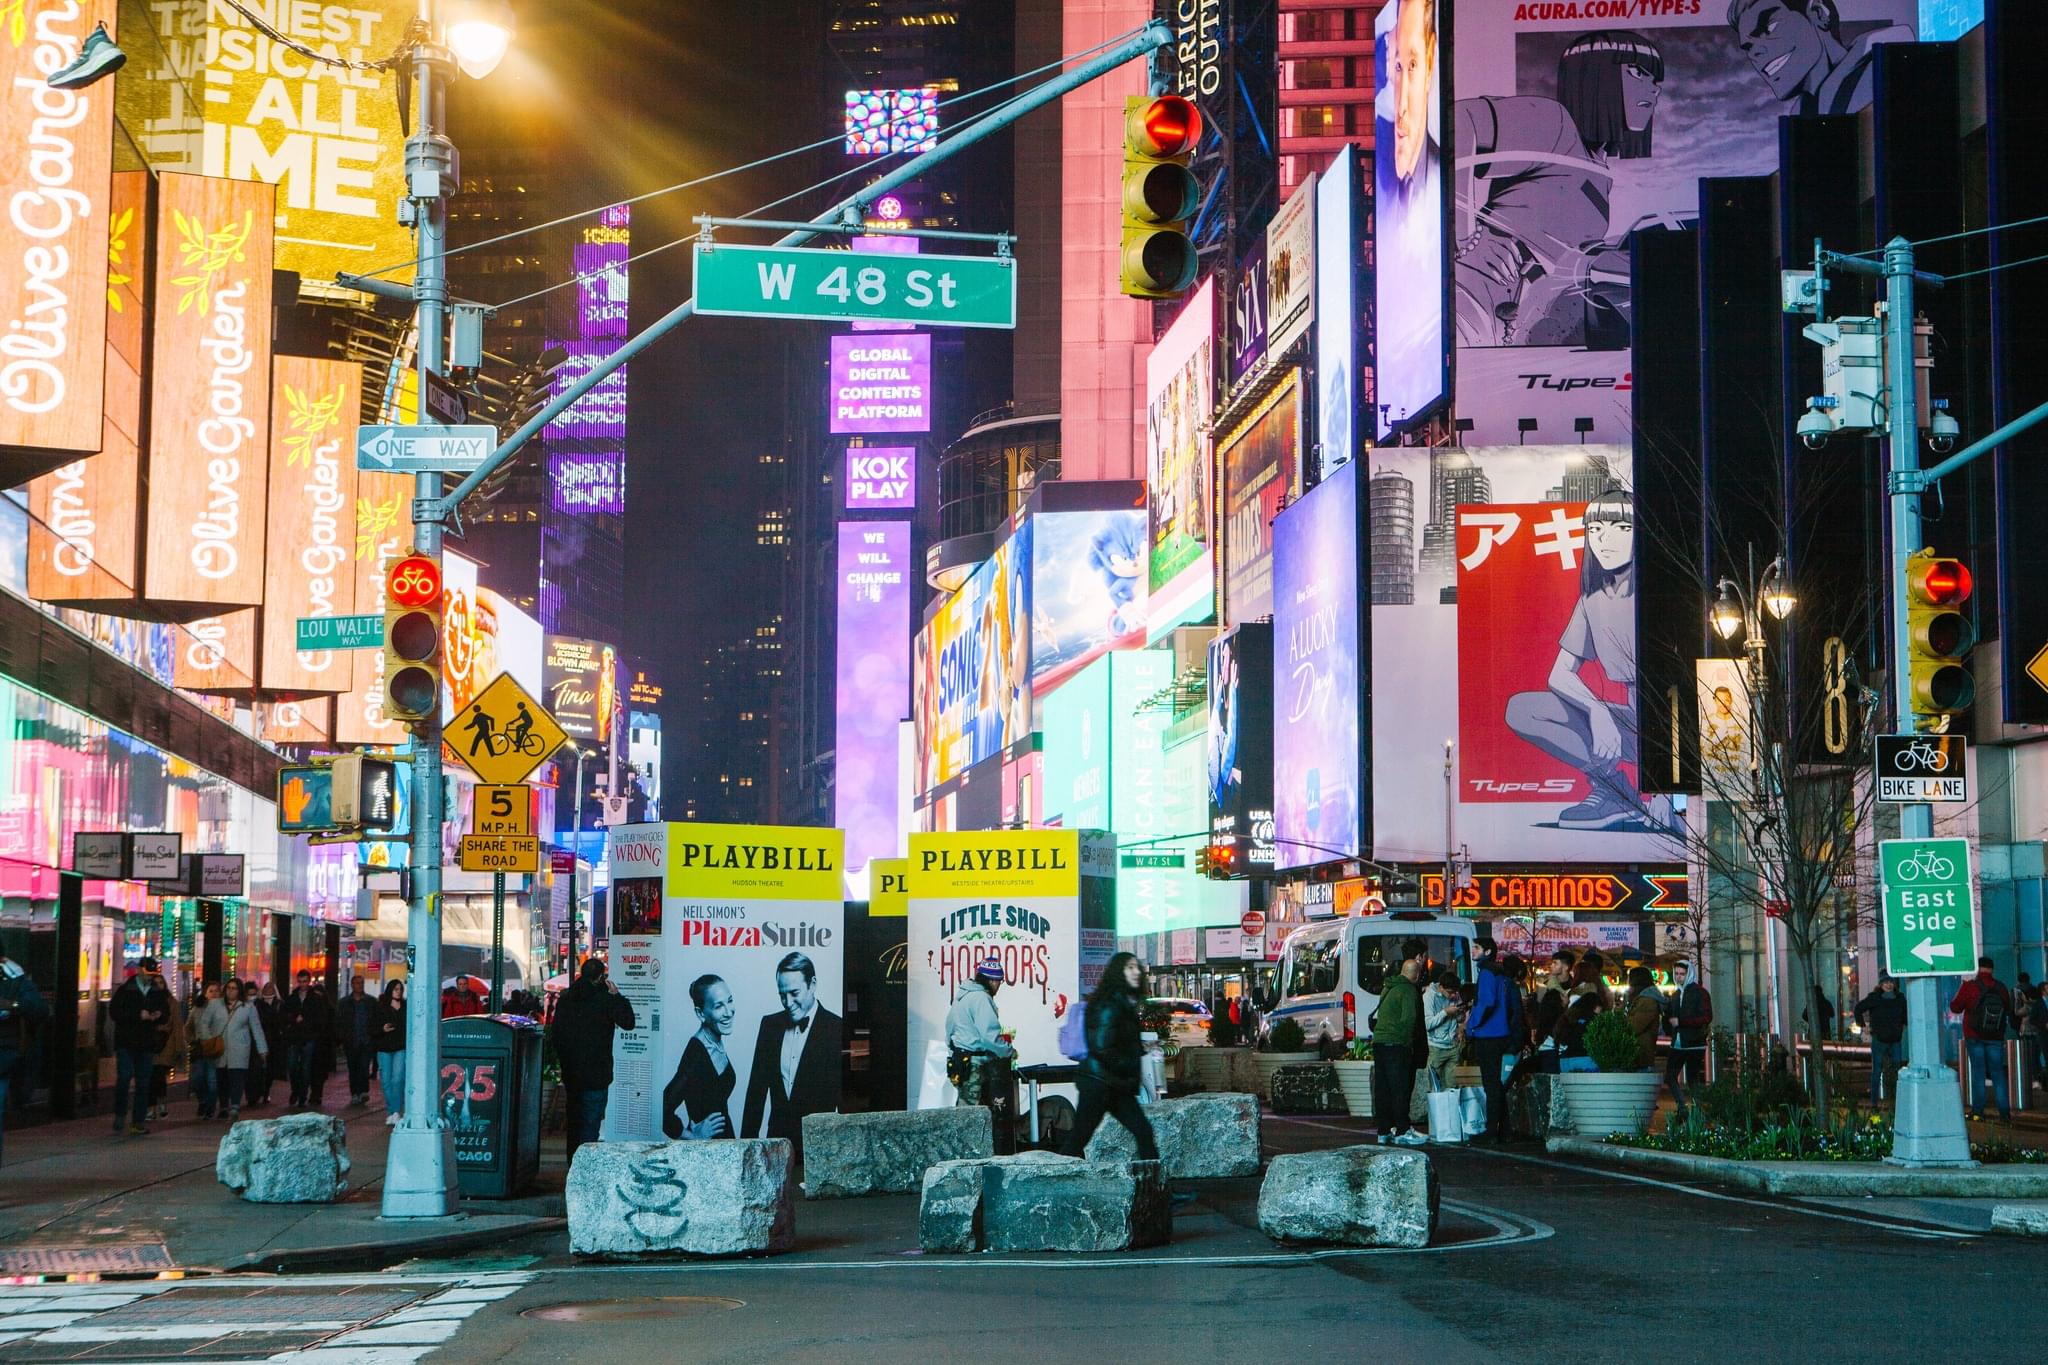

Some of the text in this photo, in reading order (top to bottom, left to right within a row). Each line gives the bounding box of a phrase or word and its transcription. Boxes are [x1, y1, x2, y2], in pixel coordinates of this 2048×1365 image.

[1514, 0, 1701, 20] ACURA.COM/TYPE-S
[246, 78, 379, 140] ALL
[0, 0, 90, 413] Olive Garden
[757, 262, 957, 308] W 48 St
[849, 349, 912, 361] GLOBAL
[849, 367, 911, 381] DIGITAL
[1518, 374, 1616, 391] Type
[431, 388, 445, 409] ONE
[838, 386, 921, 400] CONTENTS
[838, 405, 922, 419] PLATFORM
[191, 281, 255, 580] Olive Garden
[376, 440, 482, 457] ONE WAY
[852, 457, 909, 479] KOK
[852, 481, 909, 499] PLAY
[301, 439, 346, 576] Garden
[863, 533, 885, 544] WE
[1459, 508, 1587, 571] アキ
[858, 553, 891, 564] WILL
[847, 573, 901, 584] CHANGE
[300, 621, 329, 637] LOU
[1290, 602, 1338, 665] A LUCKY
[342, 636, 362, 645] WAY
[938, 615, 983, 714] SONIC
[978, 599, 995, 712] 2
[1823, 636, 1848, 754] 8
[1470, 779, 1576, 793] Type S
[1883, 780, 1962, 796] BIKE LANE
[490, 790, 512, 817] 5
[1249, 810, 1272, 820] USA
[481, 822, 521, 833] M.P.H.
[648, 831, 664, 841] GOES
[467, 840, 534, 852] SHARE THE
[1135, 768, 1154, 921] AMICAN
[482, 855, 518, 866] ROAD
[615, 843, 662, 867] WRONG
[682, 843, 833, 871] PLAYBILL
[921, 848, 1067, 871] PLAYBILL
[1136, 857, 1145, 866] W
[1161, 856, 1171, 866] St
[880, 873, 908, 892] PL
[980, 879, 1034, 887] THEATRE/UPSTAIRS
[1321, 882, 1333, 903] FIN
[1427, 878, 1613, 907] DS CAMINOS
[1902, 890, 1956, 908] East
[683, 905, 746, 920] NEIL SIMON'S
[940, 904, 1001, 939] LITTLE
[1006, 905, 1051, 939] SHOP
[1903, 912, 1957, 931] Side
[986, 931, 998, 939] OF
[1503, 926, 1527, 939] DOS
[441, 1064, 496, 1102] 25
[455, 1151, 493, 1162] CAGO
